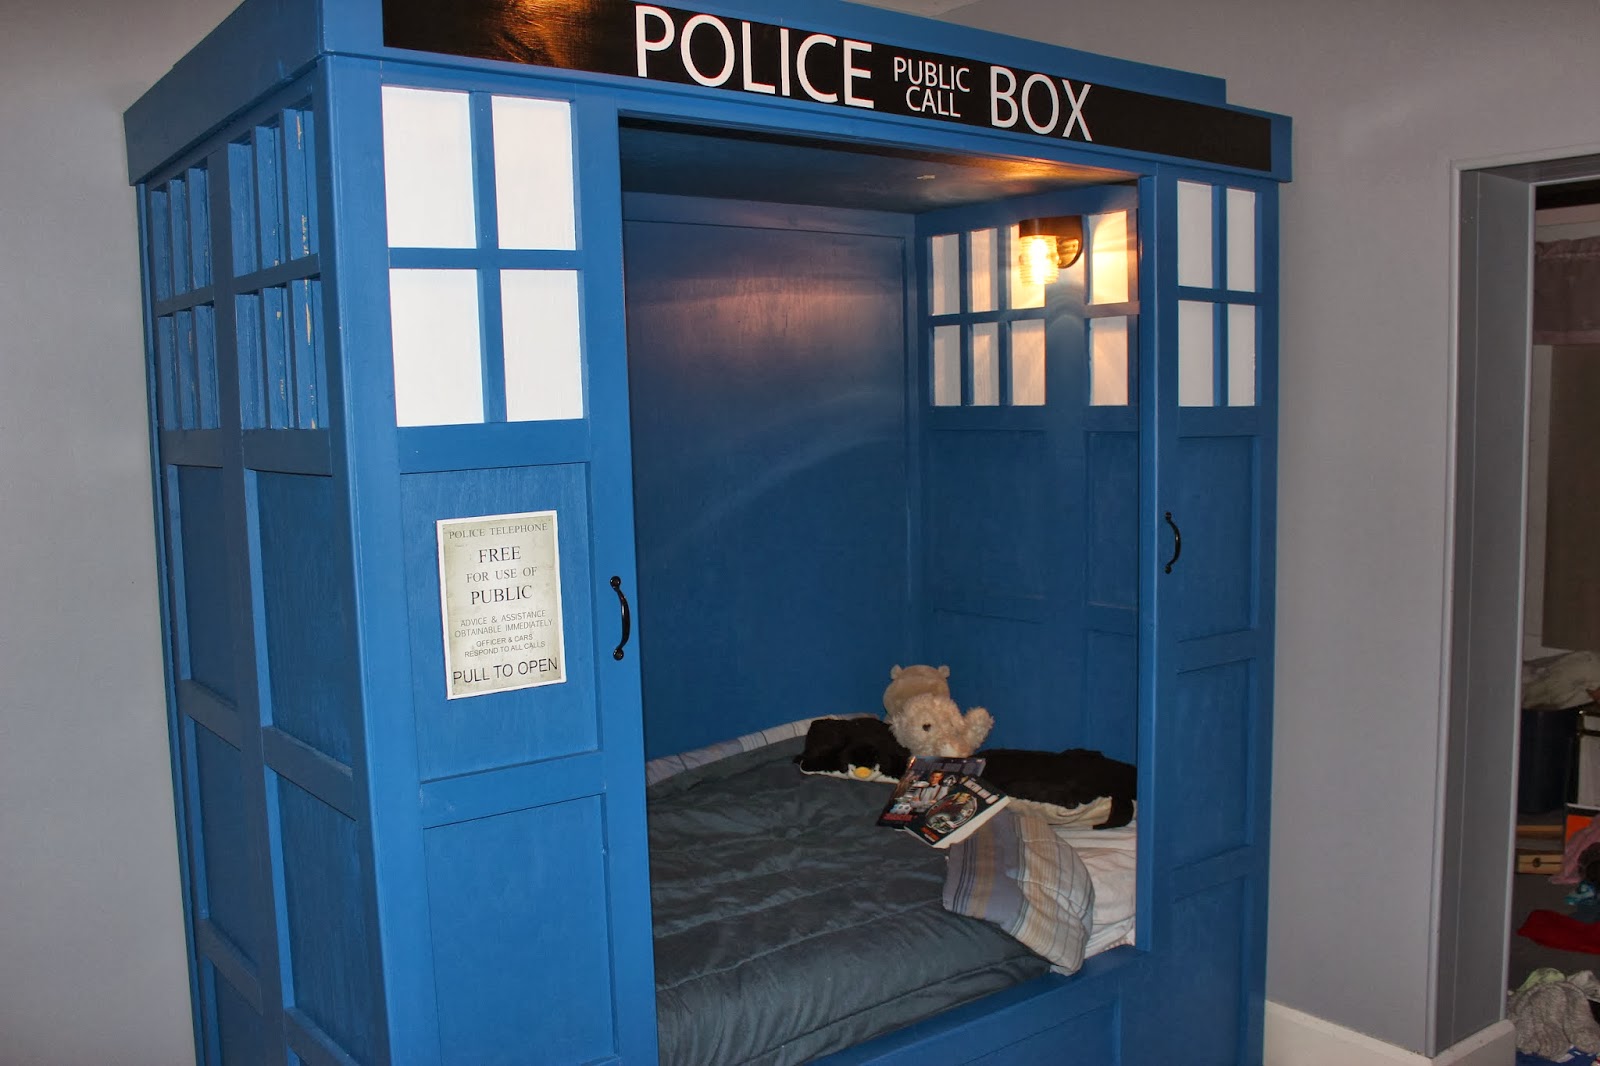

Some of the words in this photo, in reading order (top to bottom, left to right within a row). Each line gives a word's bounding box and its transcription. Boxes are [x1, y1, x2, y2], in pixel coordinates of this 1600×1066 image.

[635, 4, 874, 108] POLICE
[893, 56, 970, 93] PUBLIC
[905, 85, 961, 118] CALL
[989, 65, 1093, 142] BOX
[449, 528, 485, 539] POLICE
[490, 523, 548, 536] TELEPHONE
[478, 546, 521, 564] FREE
[466, 572, 489, 583] FOR
[495, 568, 517, 580] USE
[522, 566, 537, 577] OF
[471, 585, 532, 605] PUBLIC
[460, 617, 487, 627] ADVICE
[501, 610, 546, 622] ASSISTANCE
[454, 625, 502, 638] OBTAINABLE
[505, 619, 553, 632] IMMEDIATELY
[464, 647, 499, 658] RESPOND
[511, 643, 523, 651] ALL
[524, 640, 546, 650] CALLS
[476, 637, 506, 648] OFFICER
[514, 634, 533, 643] CARS
[453, 667, 490, 685] PULL
[493, 663, 514, 679] TO
[517, 657, 558, 675] OPEN
